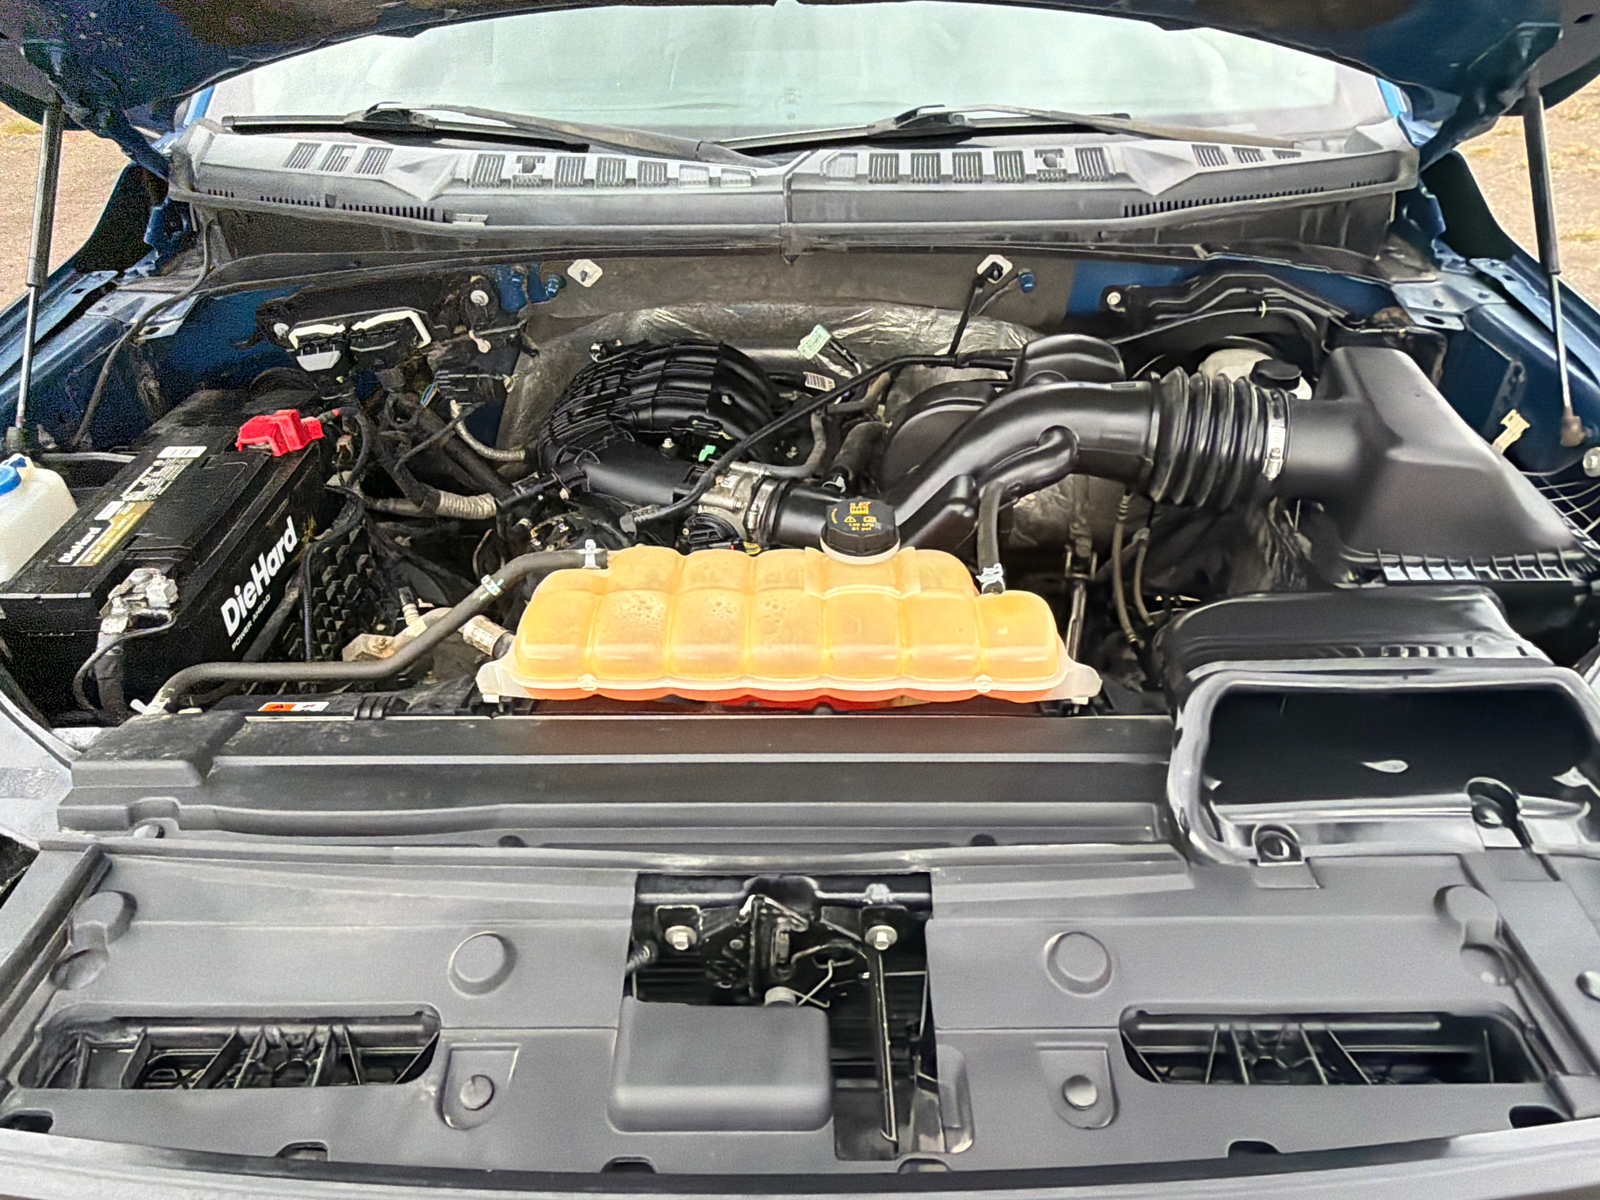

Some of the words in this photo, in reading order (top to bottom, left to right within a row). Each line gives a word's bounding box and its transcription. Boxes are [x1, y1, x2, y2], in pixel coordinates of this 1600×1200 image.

[57, 526, 102, 563] DieHard
[220, 515, 298, 637] DieHard
[231, 620, 253, 652] POWER
[252, 593, 271, 622] AHEAD
